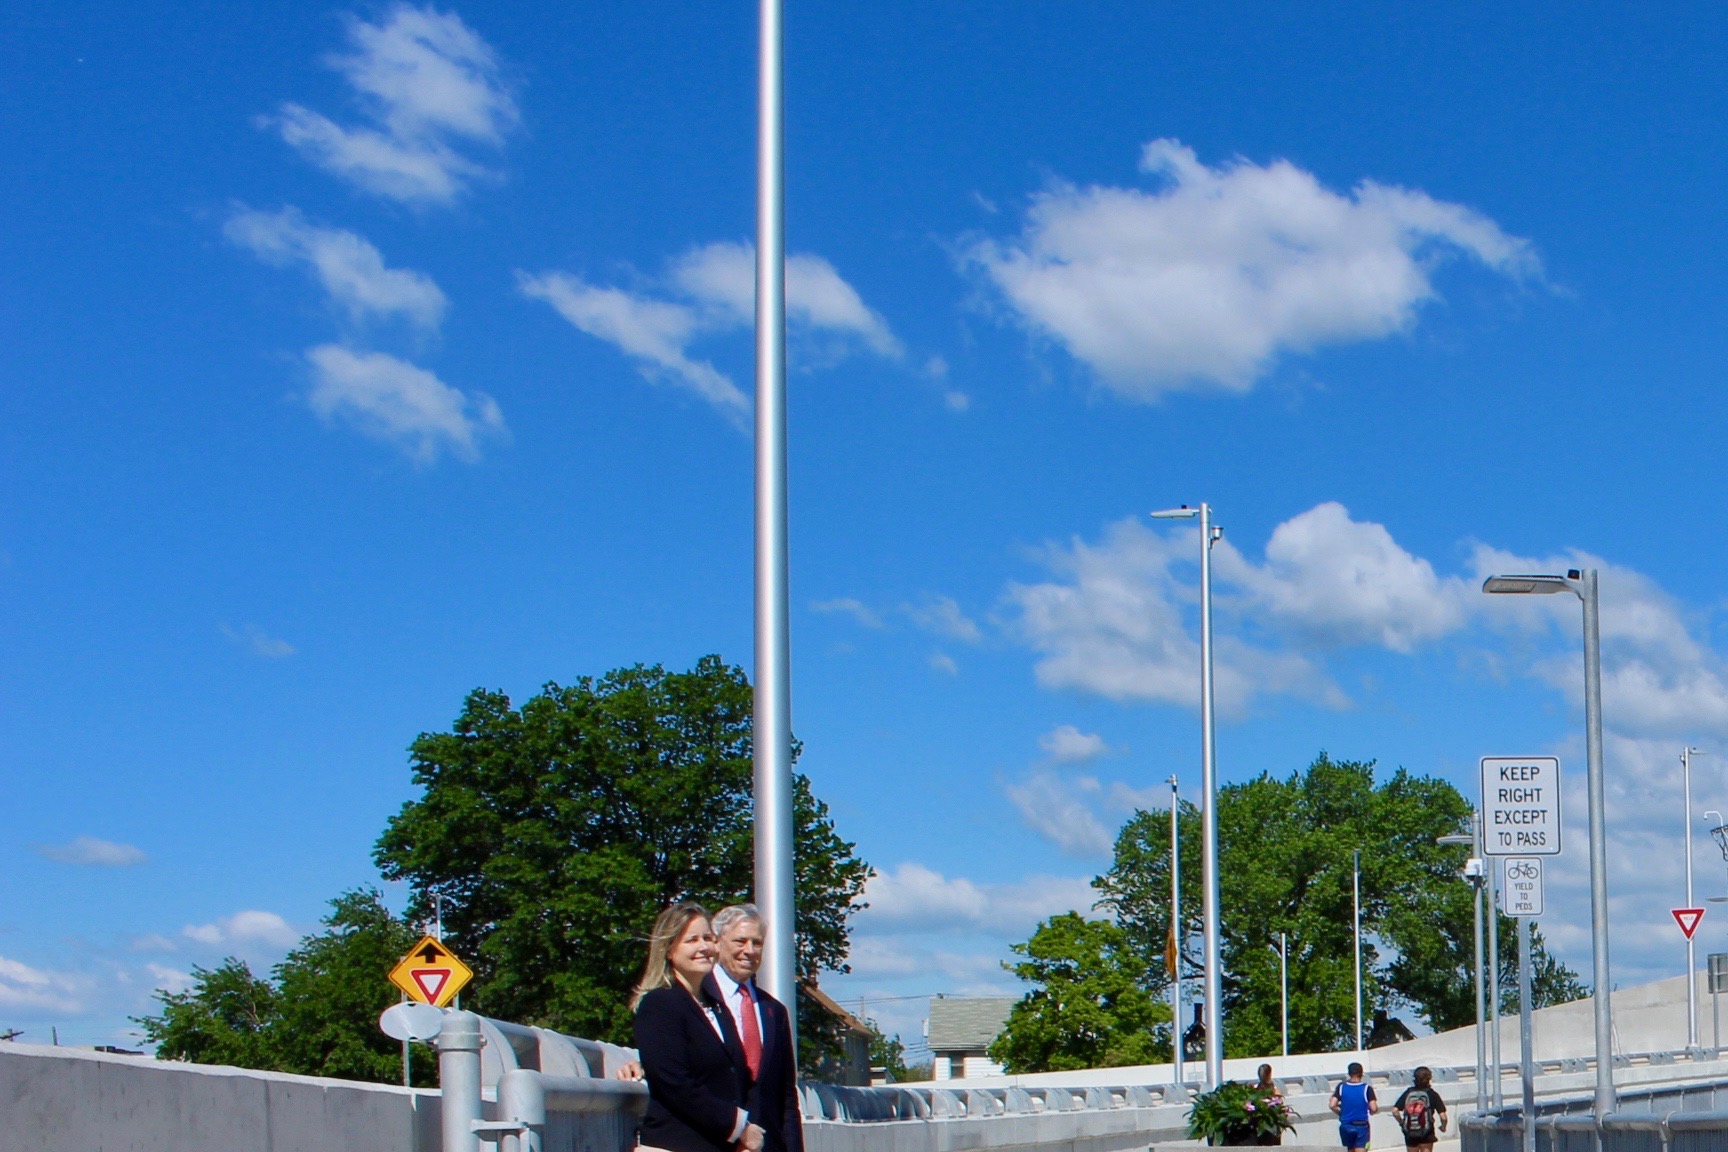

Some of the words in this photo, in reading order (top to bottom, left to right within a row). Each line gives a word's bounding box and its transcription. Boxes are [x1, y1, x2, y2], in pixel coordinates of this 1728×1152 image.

[1500, 766, 1540, 781] KEEP
[1498, 788, 1543, 803] RIGHT
[1494, 810, 1548, 825] EXCEPT
[1498, 832, 1512, 846] TO
[1517, 832, 1546, 846] PASS
[1514, 882, 1533, 891] YIELD
[1520, 892, 1528, 901] TO
[1515, 902, 1533, 911] PEDS
